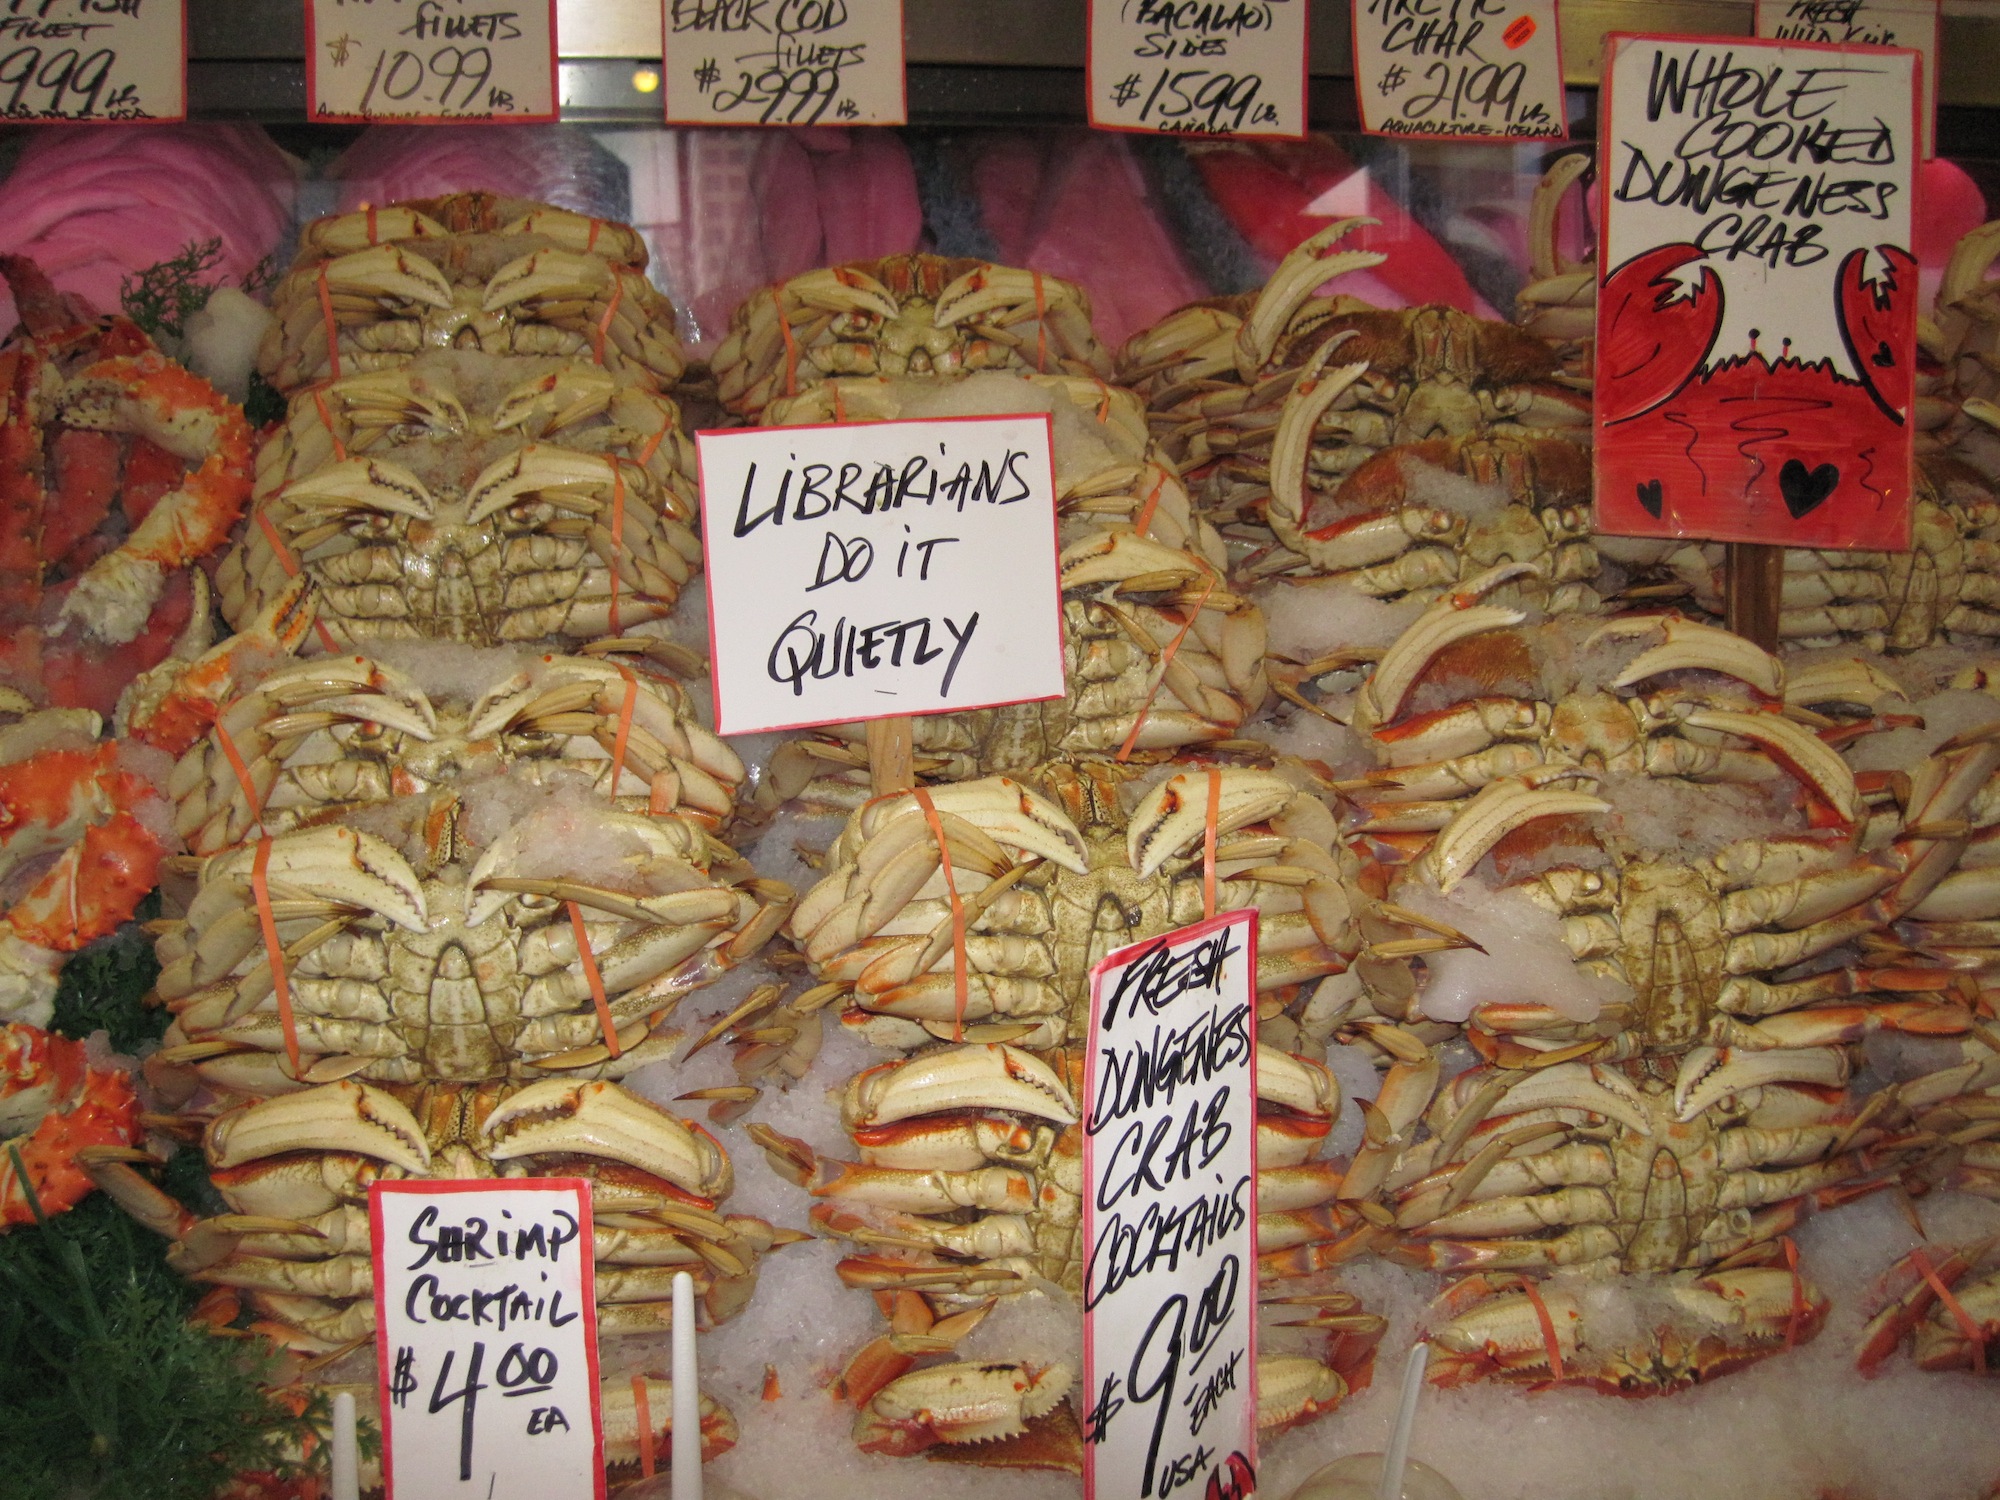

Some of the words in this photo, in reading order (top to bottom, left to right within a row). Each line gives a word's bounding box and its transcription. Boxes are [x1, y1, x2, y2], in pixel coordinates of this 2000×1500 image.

[775, 0, 848, 34] COD
[1134, 33, 1228, 59] SIDES
[1381, 17, 1487, 64] CHAR
[1646, 49, 1889, 122] WHOLE
[1674, 110, 1895, 165] COOKED
[1614, 141, 1898, 220] DUNGENESS
[1697, 212, 1829, 268] CRAB
[733, 442, 1031, 538] LIBRARIANS
[805, 531, 875, 592] DO
[767, 609, 980, 697] QUIETLY
[1101, 926, 1242, 1032] FRESH
[1086, 1003, 1252, 1136] DUNGENESS
[1096, 1085, 1233, 1212] CRAB
[406, 1205, 580, 1270] SHRIMP
[1084, 1173, 1252, 1313] COCKTAILS
[405, 1270, 579, 1332] COCKTAIL
[526, 1406, 571, 1435] EA
[1183, 1347, 1245, 1436] EACH
[1158, 1444, 1216, 1500] USA
